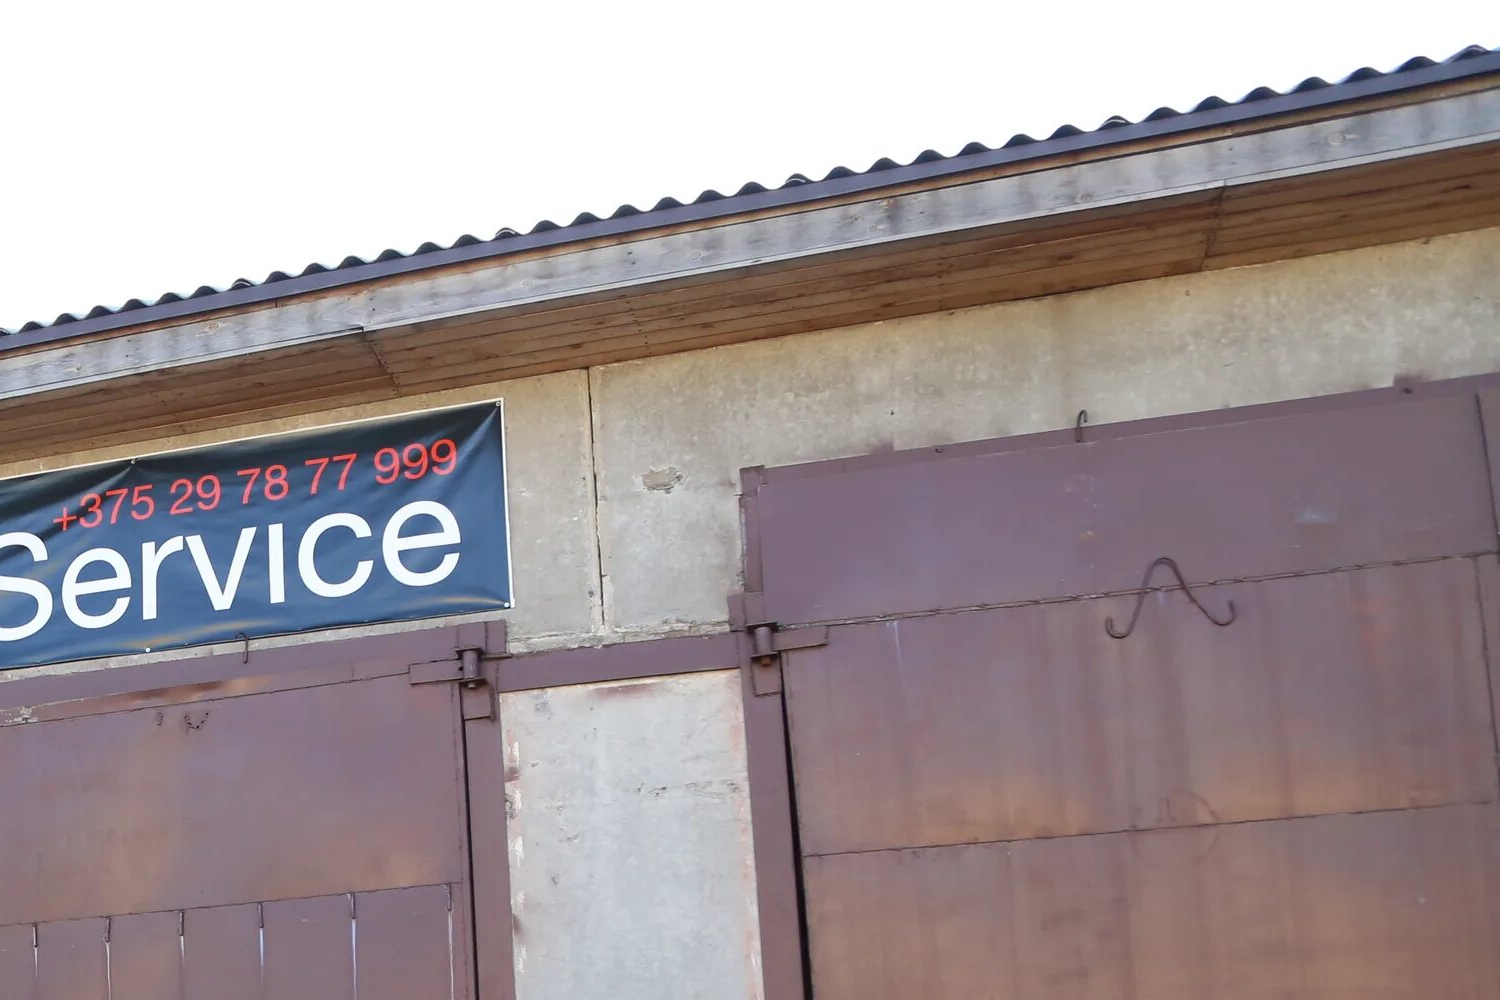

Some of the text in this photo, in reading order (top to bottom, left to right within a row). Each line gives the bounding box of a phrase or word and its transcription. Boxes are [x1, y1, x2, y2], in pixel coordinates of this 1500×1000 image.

[54, 440, 457, 532] +375 29 78 77 999
